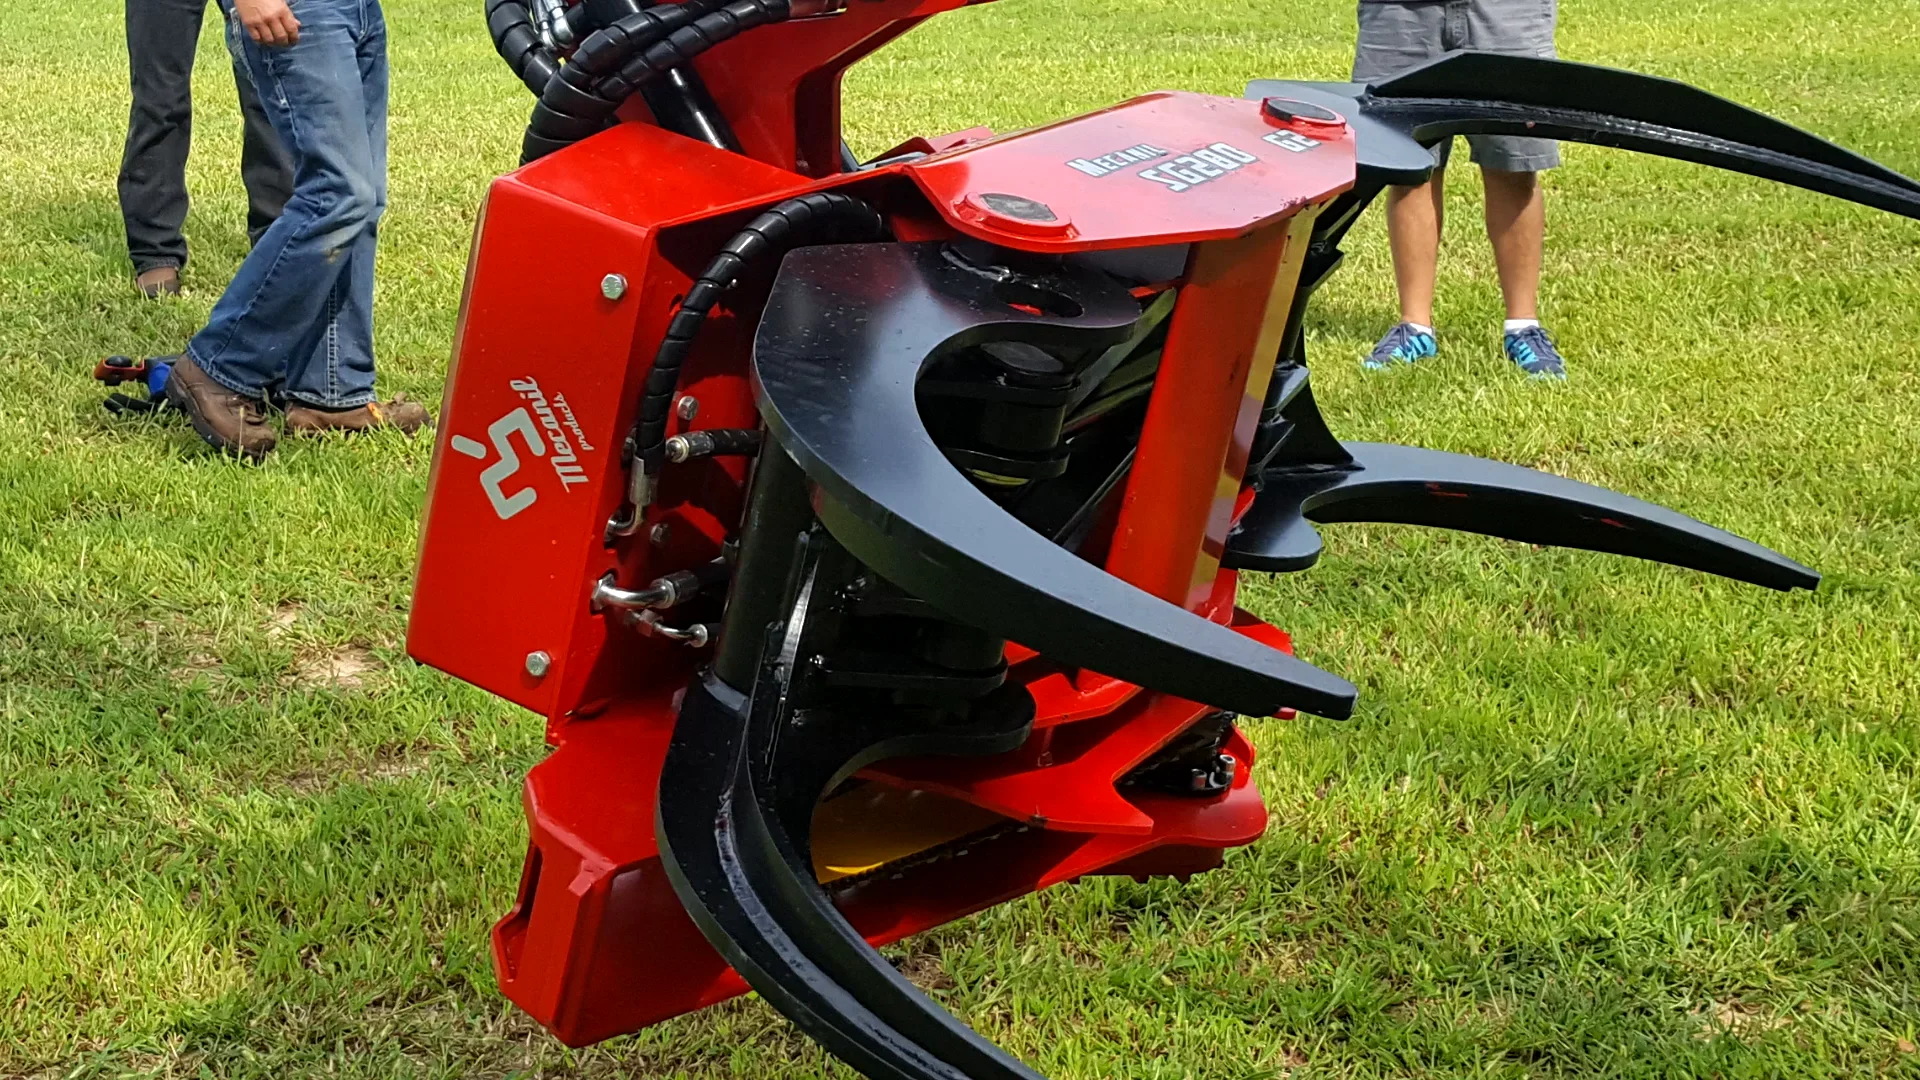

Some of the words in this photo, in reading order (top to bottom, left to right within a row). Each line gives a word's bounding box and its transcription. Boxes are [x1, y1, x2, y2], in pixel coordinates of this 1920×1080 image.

[1138, 142, 1259, 192] SG280
[1262, 129, 1322, 152] G2
[510, 376, 589, 493] Mecanil
